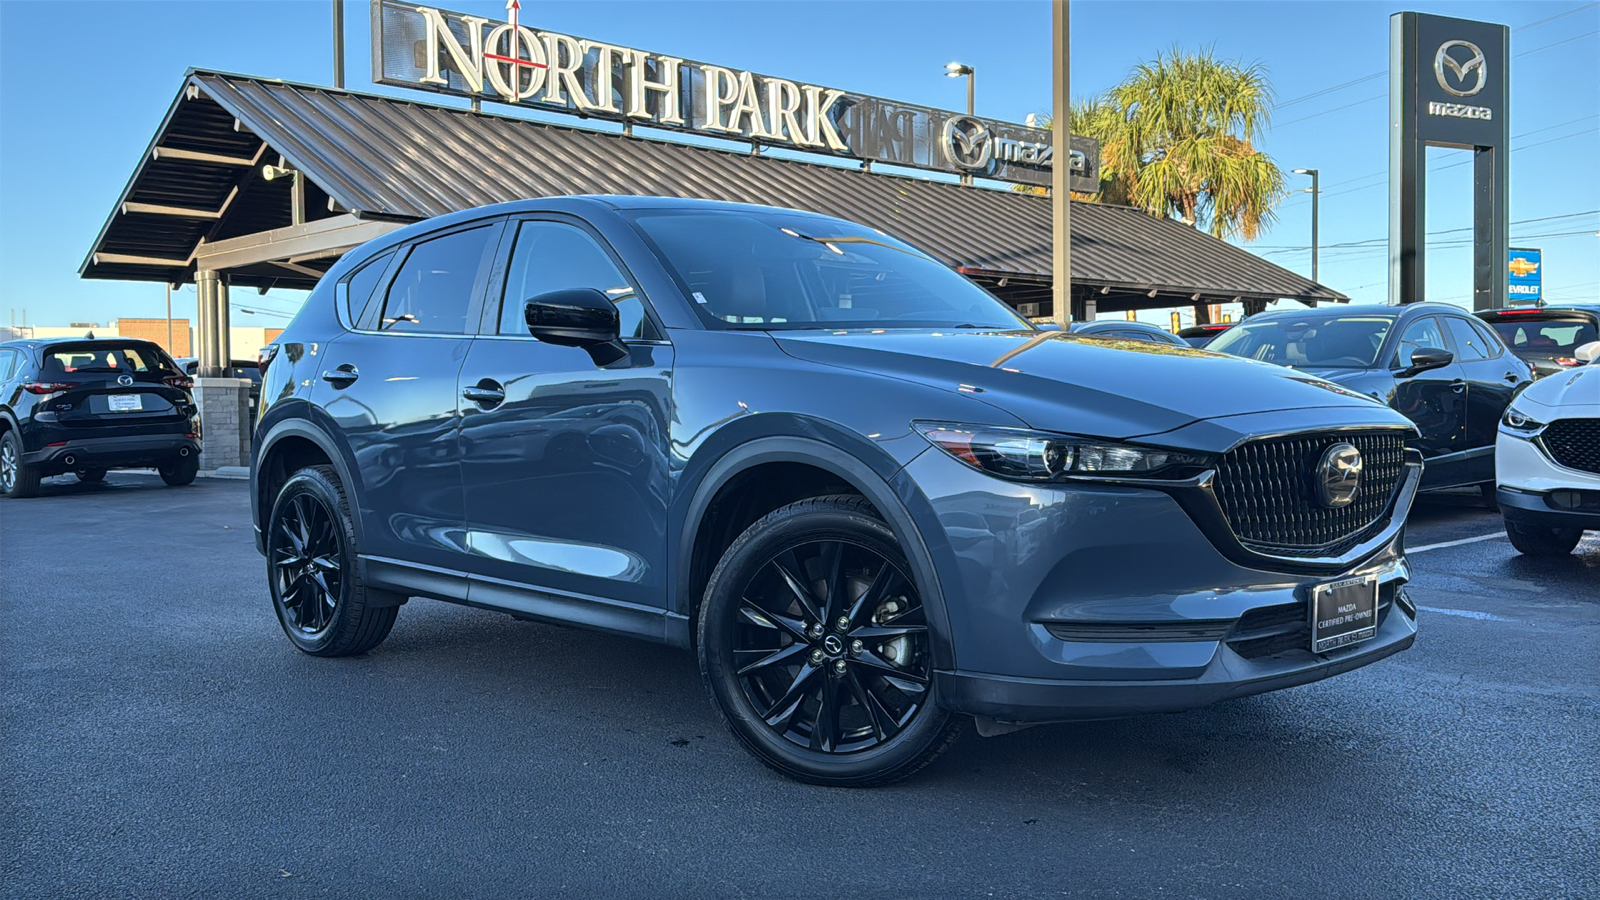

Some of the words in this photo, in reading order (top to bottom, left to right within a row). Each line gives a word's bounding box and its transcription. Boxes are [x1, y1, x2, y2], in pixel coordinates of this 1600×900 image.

[416, 6, 685, 124] NORTH
[700, 64, 848, 150] PARK
[1429, 101, 1492, 120] mazda
[994, 136, 1086, 171] maza
[1509, 285, 1539, 294] EVROLET
[1337, 603, 1357, 614] MAZDA
[1318, 616, 1344, 629] CERTIFIED
[1344, 610, 1372, 623] PRE-OWNED
